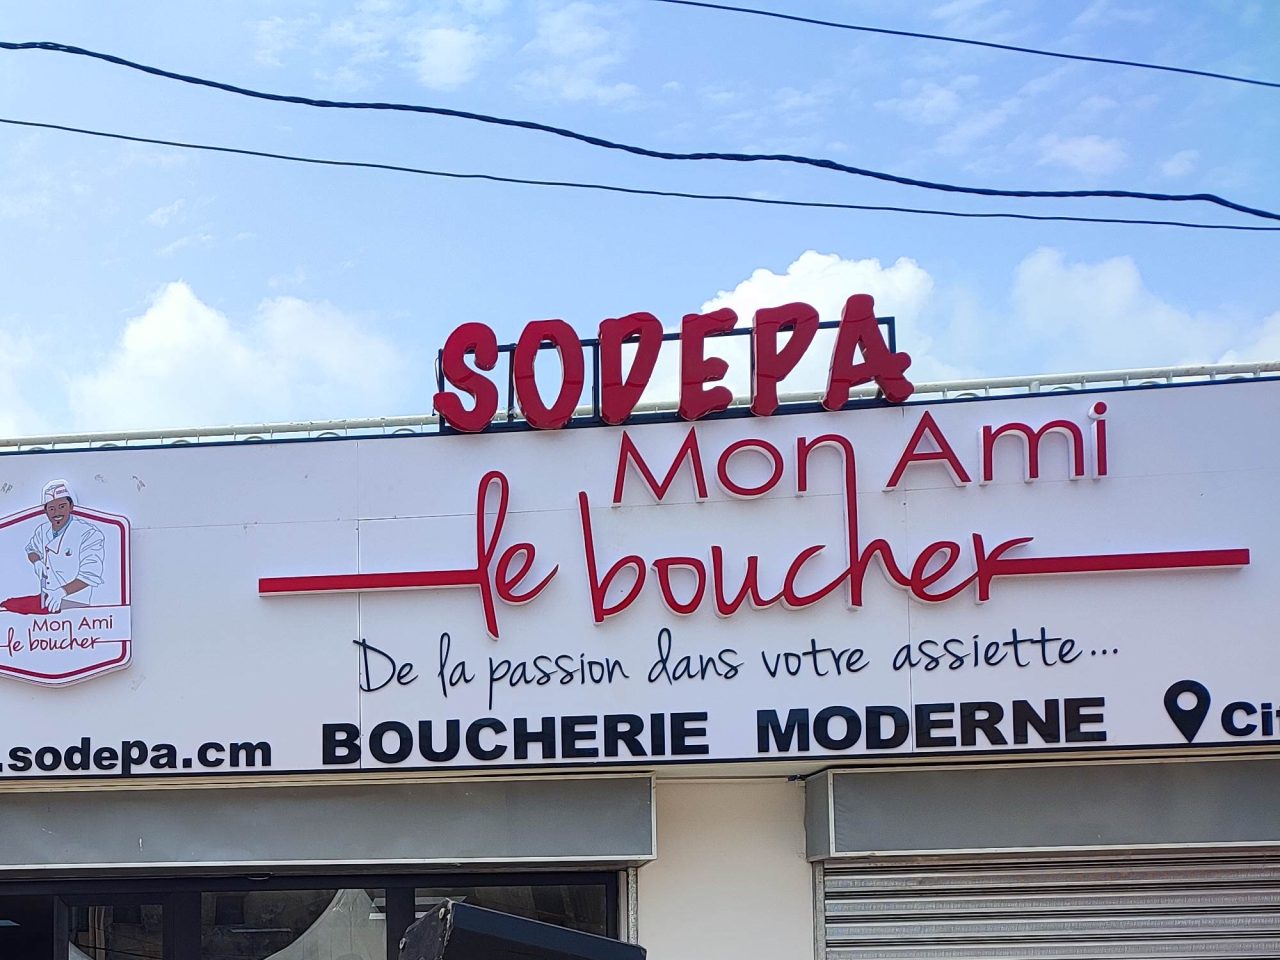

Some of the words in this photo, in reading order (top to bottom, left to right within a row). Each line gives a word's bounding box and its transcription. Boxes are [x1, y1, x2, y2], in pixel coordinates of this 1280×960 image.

[433, 293, 915, 432] SODEPA
[613, 426, 857, 505] Mon
[885, 402, 1109, 490] Ami
[477, 470, 559, 640] le
[578, 490, 1034, 623] boucher
[8, 627, 24, 657] le
[28, 628, 101, 652] boucher
[32, 618, 73, 632] Mon
[78, 614, 113, 631] Ami
[353, 637, 419, 692] De
[437, 632, 475, 697] la
[488, 649, 630, 710] passion
[647, 627, 744, 686] dans
[761, 637, 871, 678] votre
[321, 711, 710, 765] BOUCHERIE
[756, 697, 1108, 753] MODERNE
[1220, 701, 1280, 737] Ci
